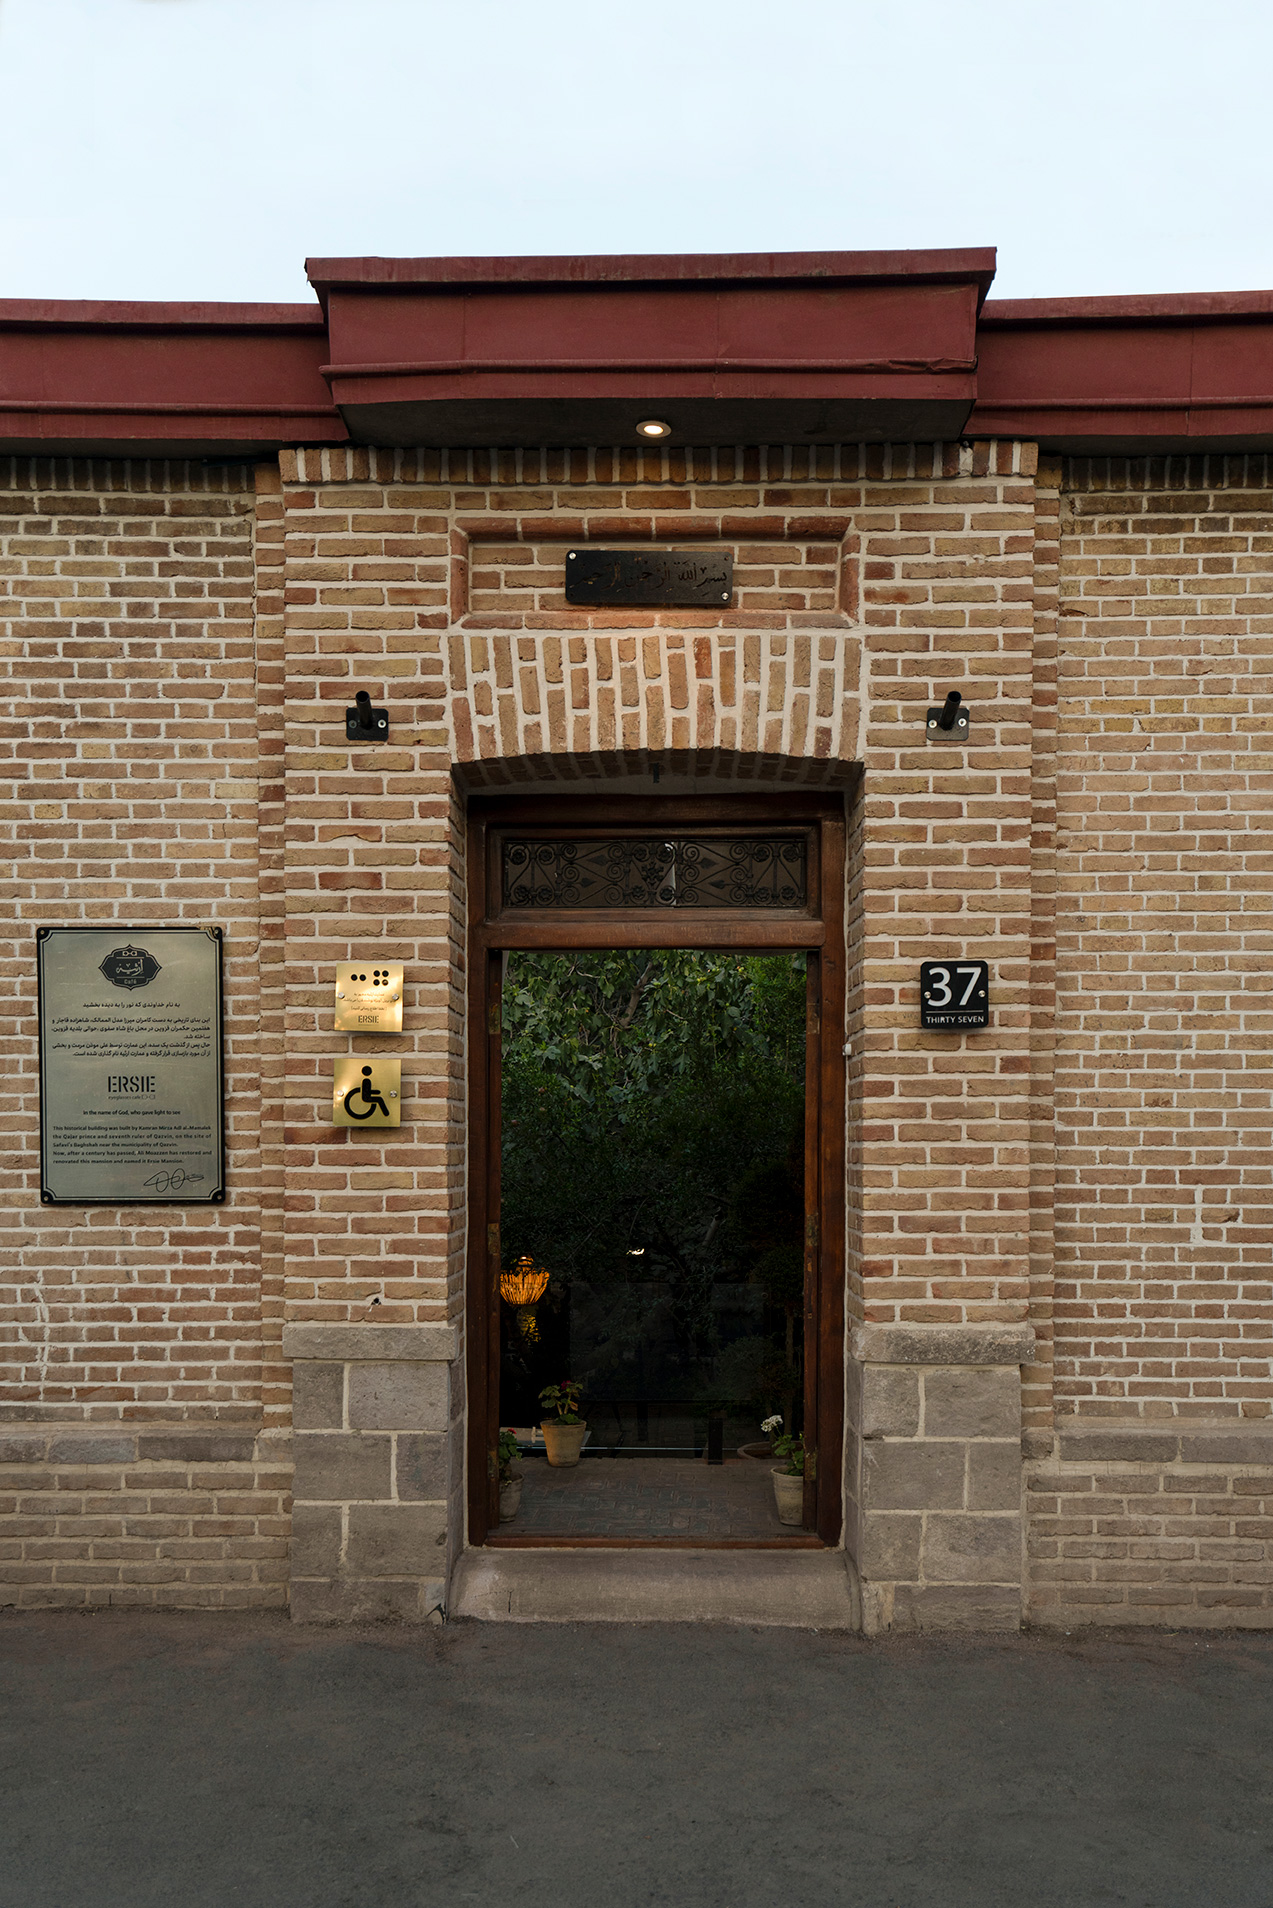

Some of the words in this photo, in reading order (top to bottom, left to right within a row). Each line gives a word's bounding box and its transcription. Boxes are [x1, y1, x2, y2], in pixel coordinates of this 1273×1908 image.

[928, 967, 982, 1007] 37
[358, 1015, 379, 1023] ERSIE
[108, 1076, 155, 1092] ERSIE
